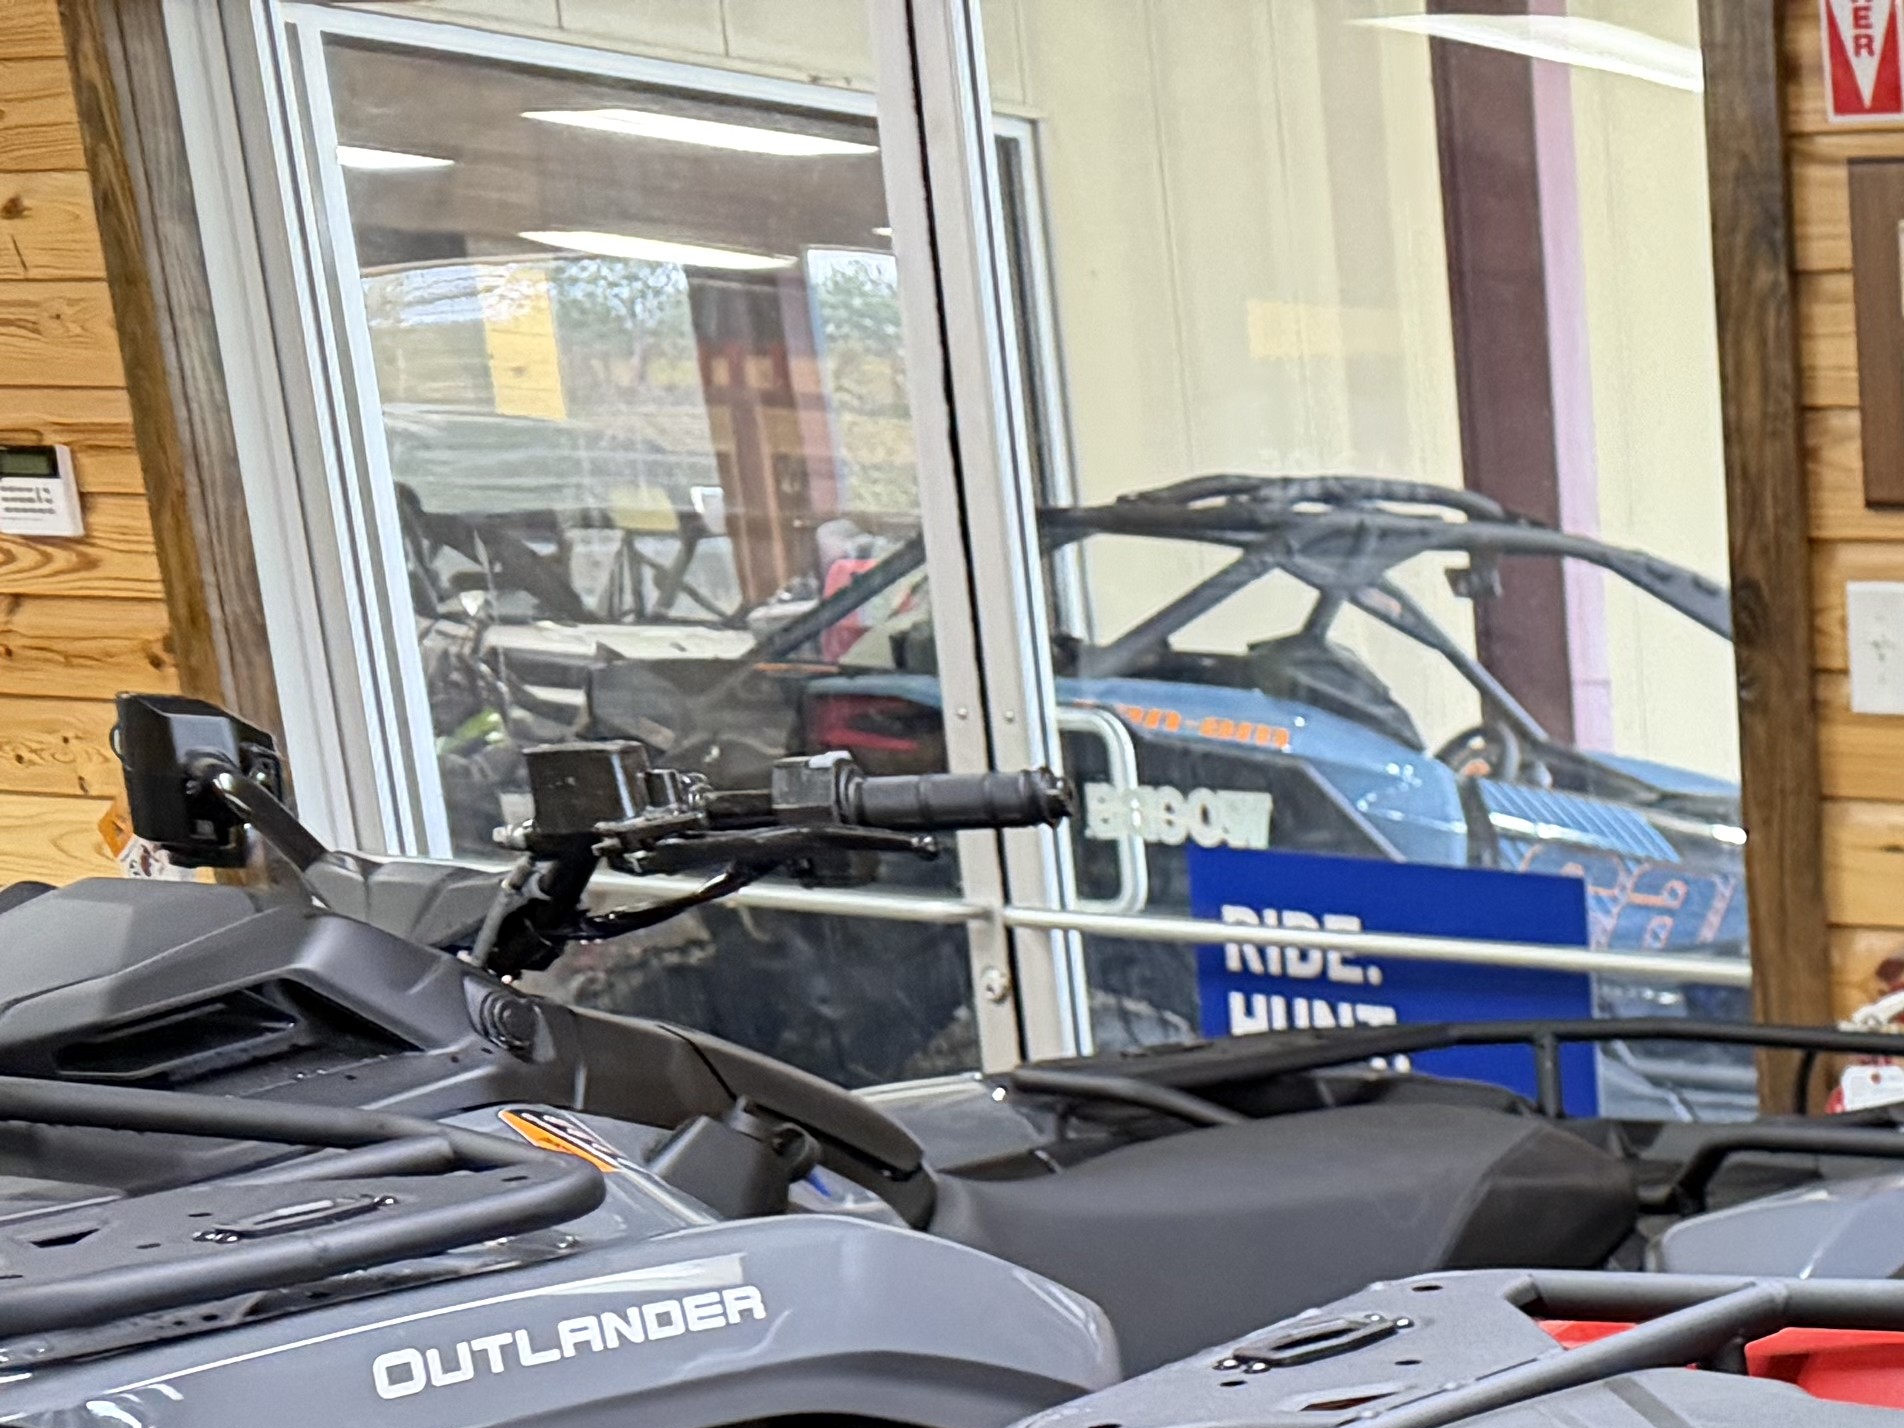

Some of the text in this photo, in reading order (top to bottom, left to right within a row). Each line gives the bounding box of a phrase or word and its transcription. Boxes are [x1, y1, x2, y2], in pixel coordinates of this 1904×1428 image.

[1853, 0, 1875, 57] ER
[1221, 903, 1383, 986] RIDE.
[373, 1284, 767, 1400] OUTLANDER
